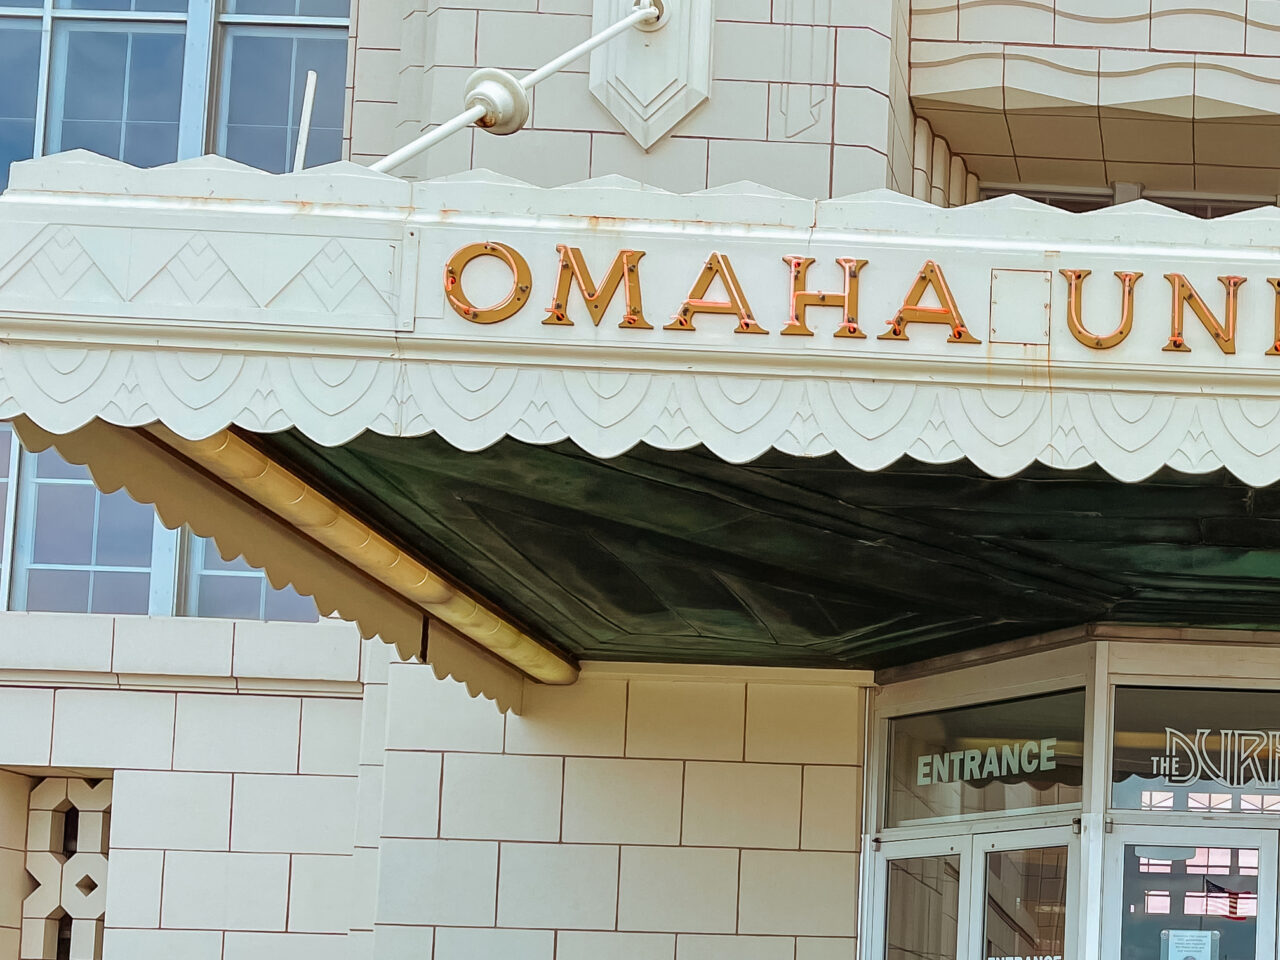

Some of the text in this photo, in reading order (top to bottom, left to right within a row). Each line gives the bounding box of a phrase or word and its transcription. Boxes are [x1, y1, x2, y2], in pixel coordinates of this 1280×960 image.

[443, 241, 982, 345] OMAHA
[917, 737, 1057, 786] ENTRANCE
[1151, 756, 1180, 775] THE
